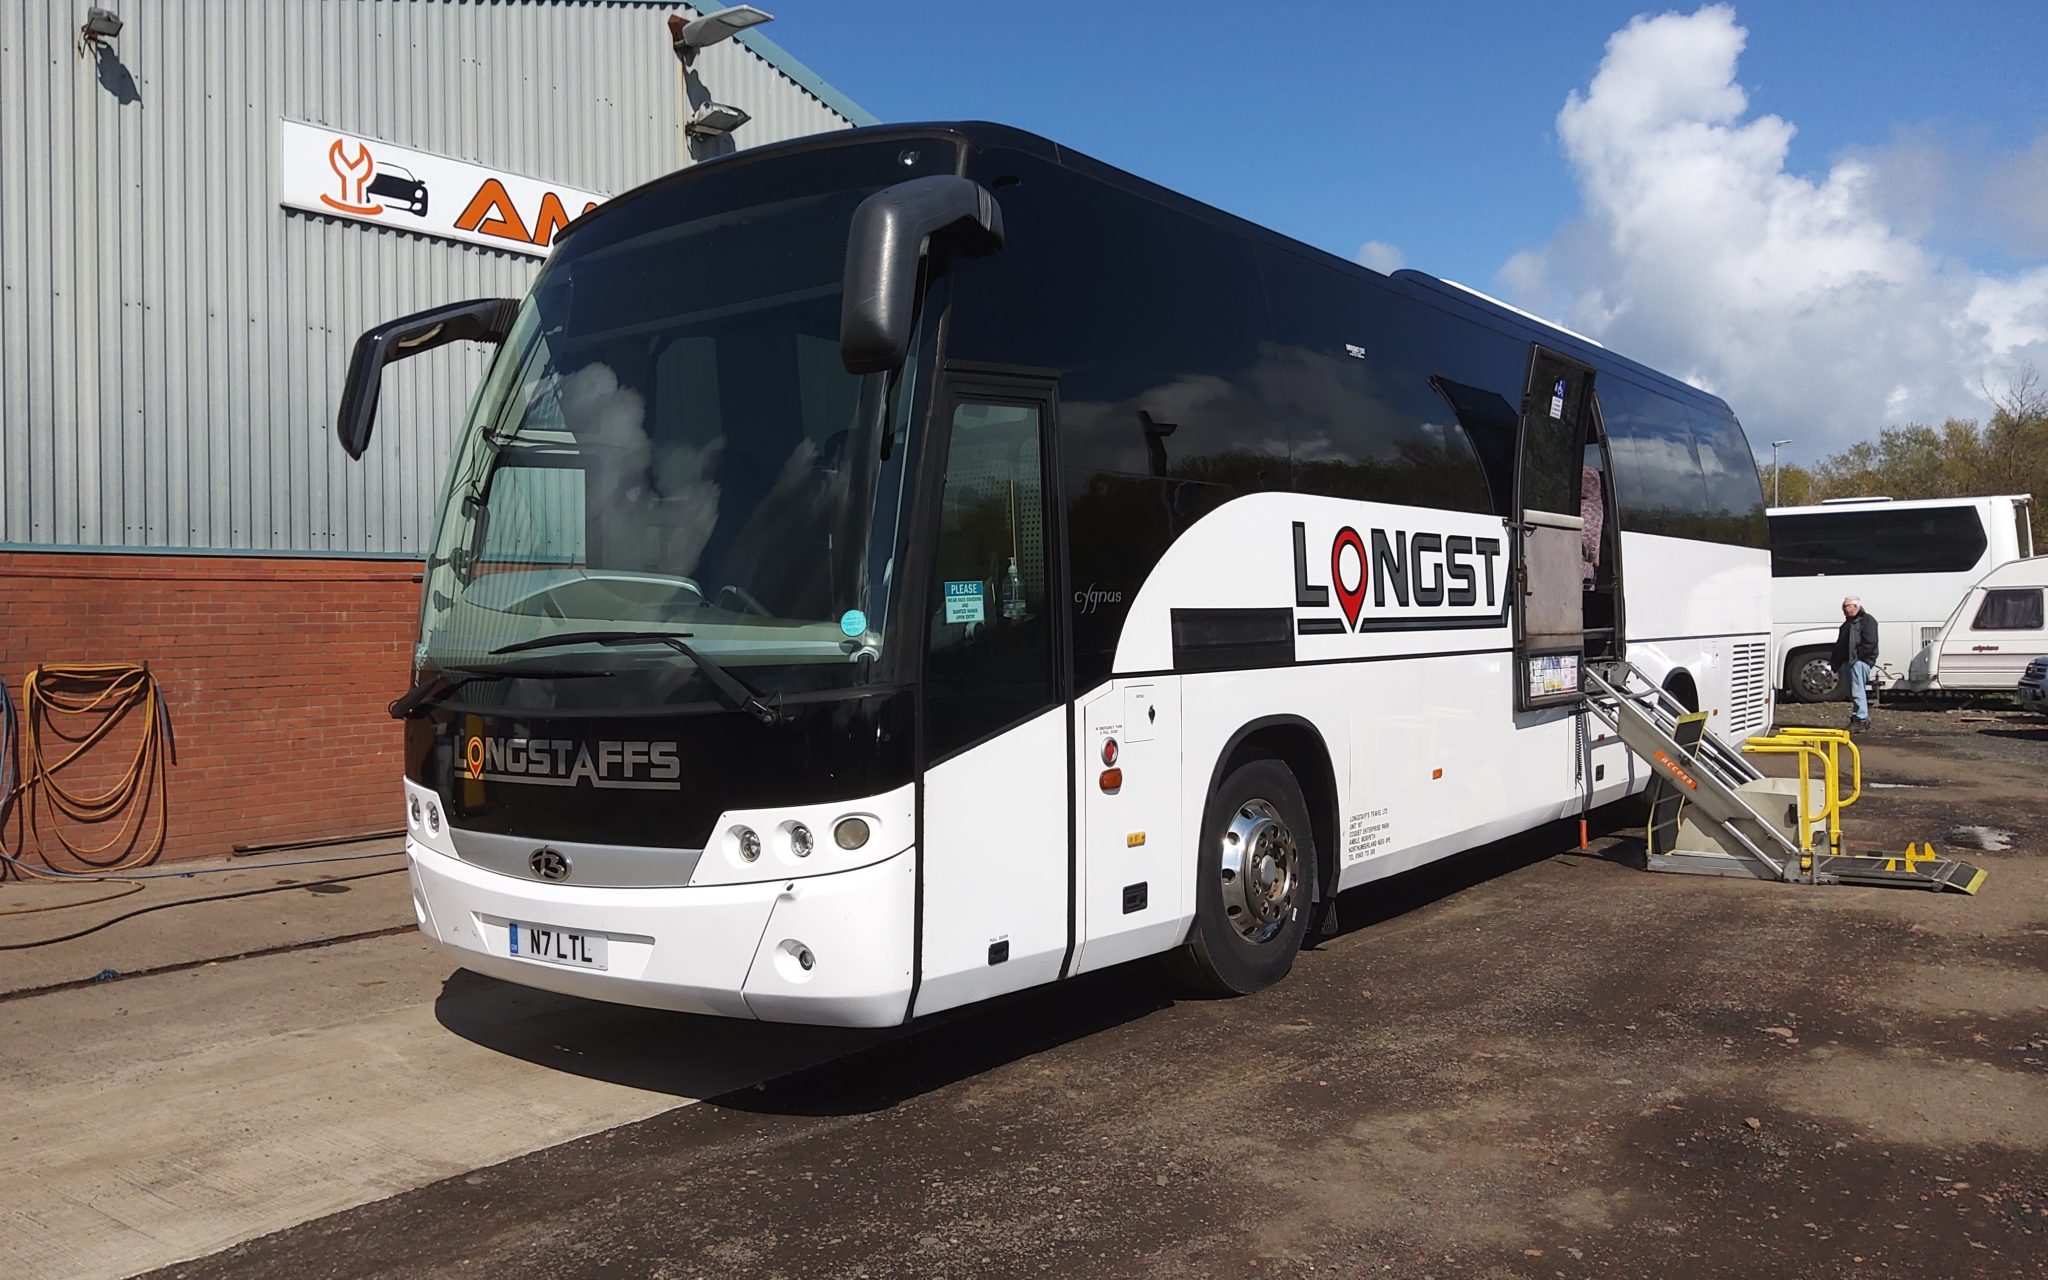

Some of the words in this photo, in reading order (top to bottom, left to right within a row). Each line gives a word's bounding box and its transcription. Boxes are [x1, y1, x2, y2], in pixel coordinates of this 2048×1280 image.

[951, 584, 977, 595] PLEASE
[1074, 582, 1122, 614] cygnus
[454, 735, 681, 786] LONGSTAFFS
[1661, 757, 1693, 784] access
[531, 929, 551, 956] N7
[556, 933, 593, 963] LTL
